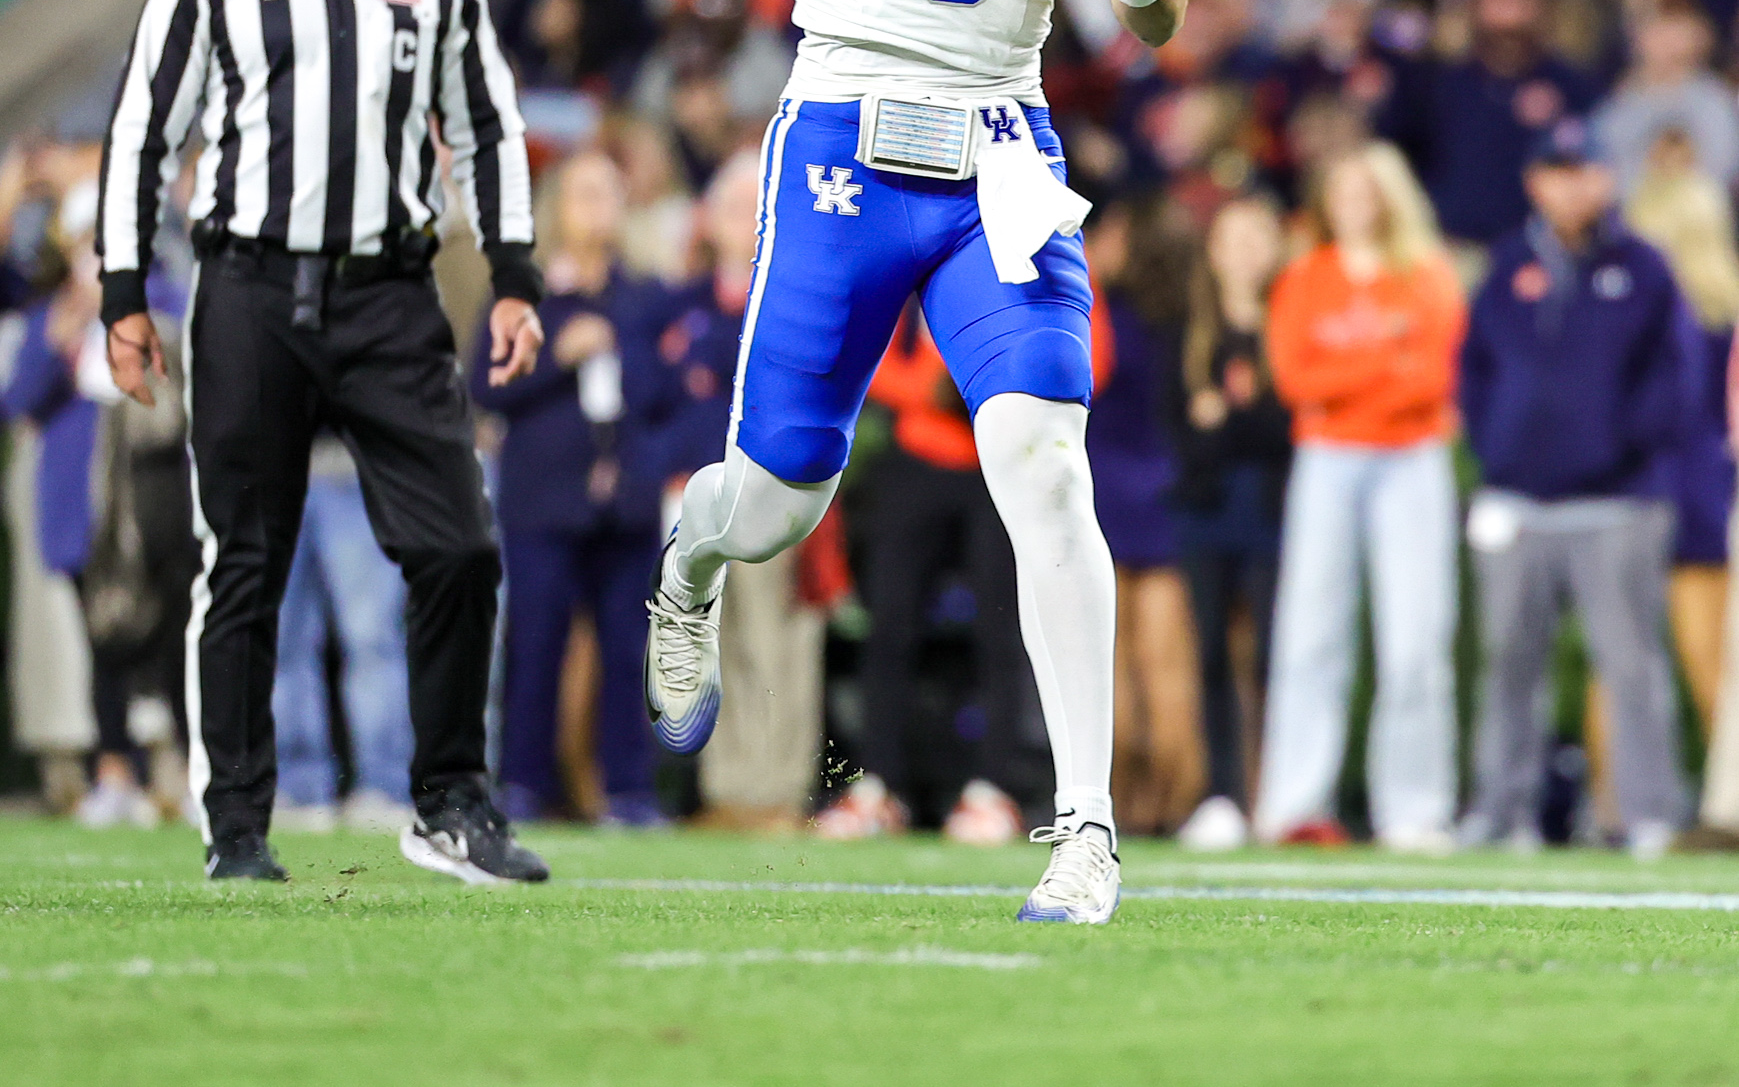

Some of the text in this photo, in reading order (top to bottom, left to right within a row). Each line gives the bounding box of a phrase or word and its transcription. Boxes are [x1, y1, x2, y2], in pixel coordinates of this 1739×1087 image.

[394, 28, 417, 73] C
[979, 105, 1022, 144] UK
[805, 163, 863, 216] UK
